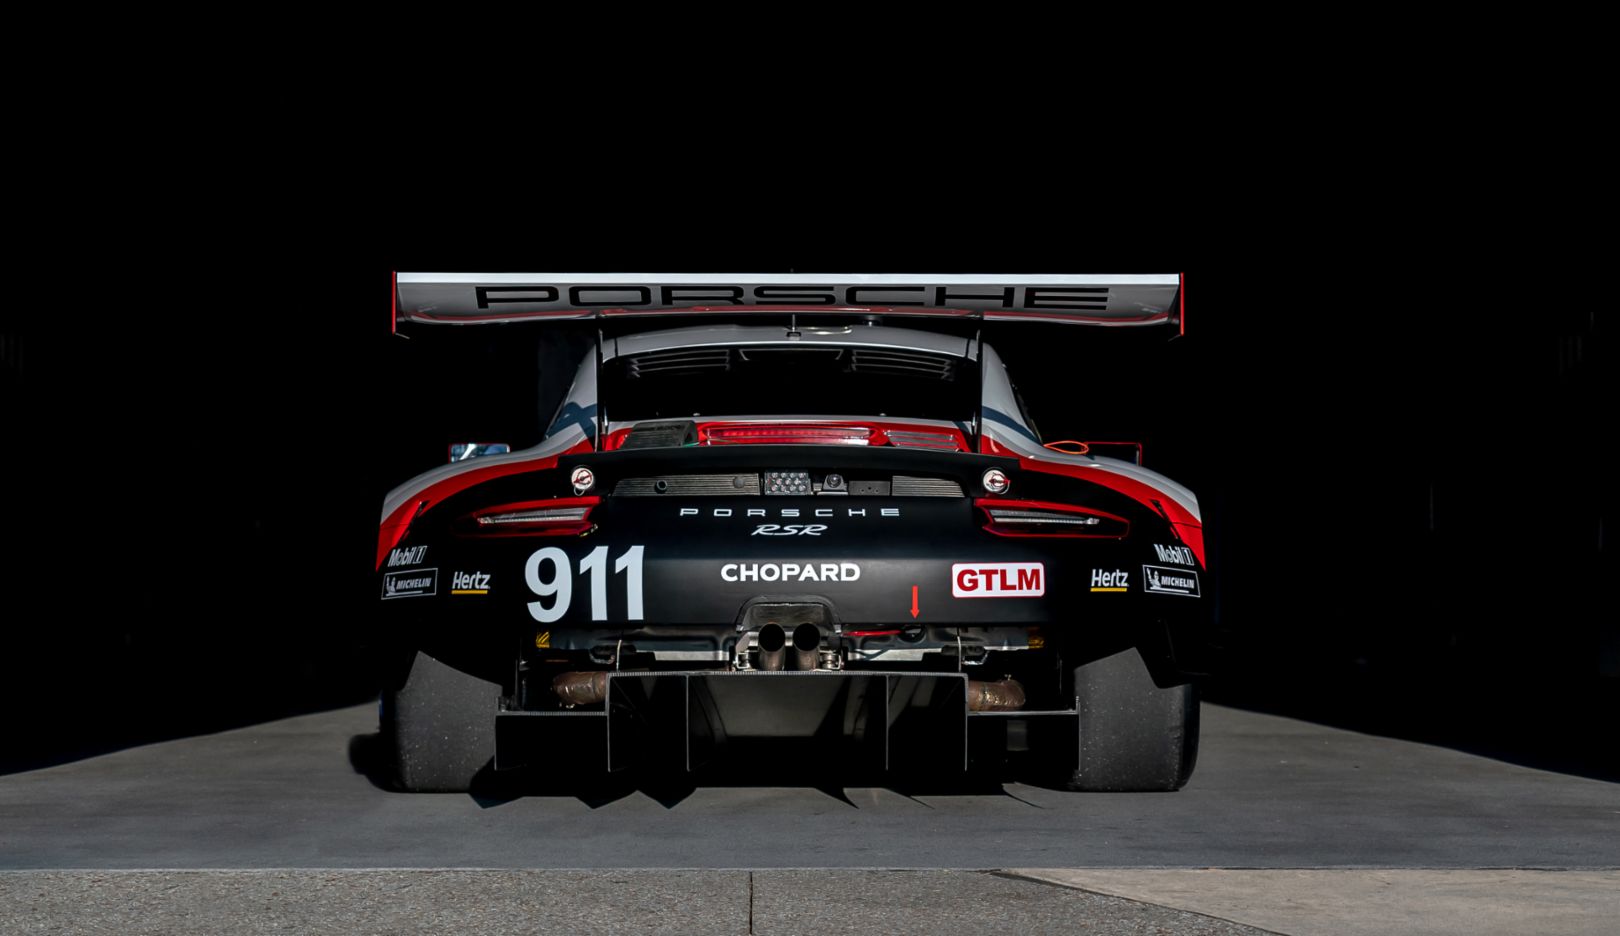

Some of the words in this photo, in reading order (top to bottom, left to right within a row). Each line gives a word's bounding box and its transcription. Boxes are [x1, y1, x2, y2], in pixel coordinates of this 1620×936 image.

[475, 285, 1109, 310] PORSCHE
[679, 508, 900, 517] PORSCHE
[751, 524, 828, 536] RSR
[388, 546, 416, 567] Mobil
[1153, 544, 1185, 564] Mobil
[452, 571, 491, 589] Hertz
[720, 563, 861, 582] CHOPARD
[956, 568, 1041, 591] GTLM
[1091, 569, 1129, 587] Hertz
[396, 577, 432, 590] MICHELIN
[524, 545, 645, 623] 911
[1161, 575, 1195, 589] MICHELIN
